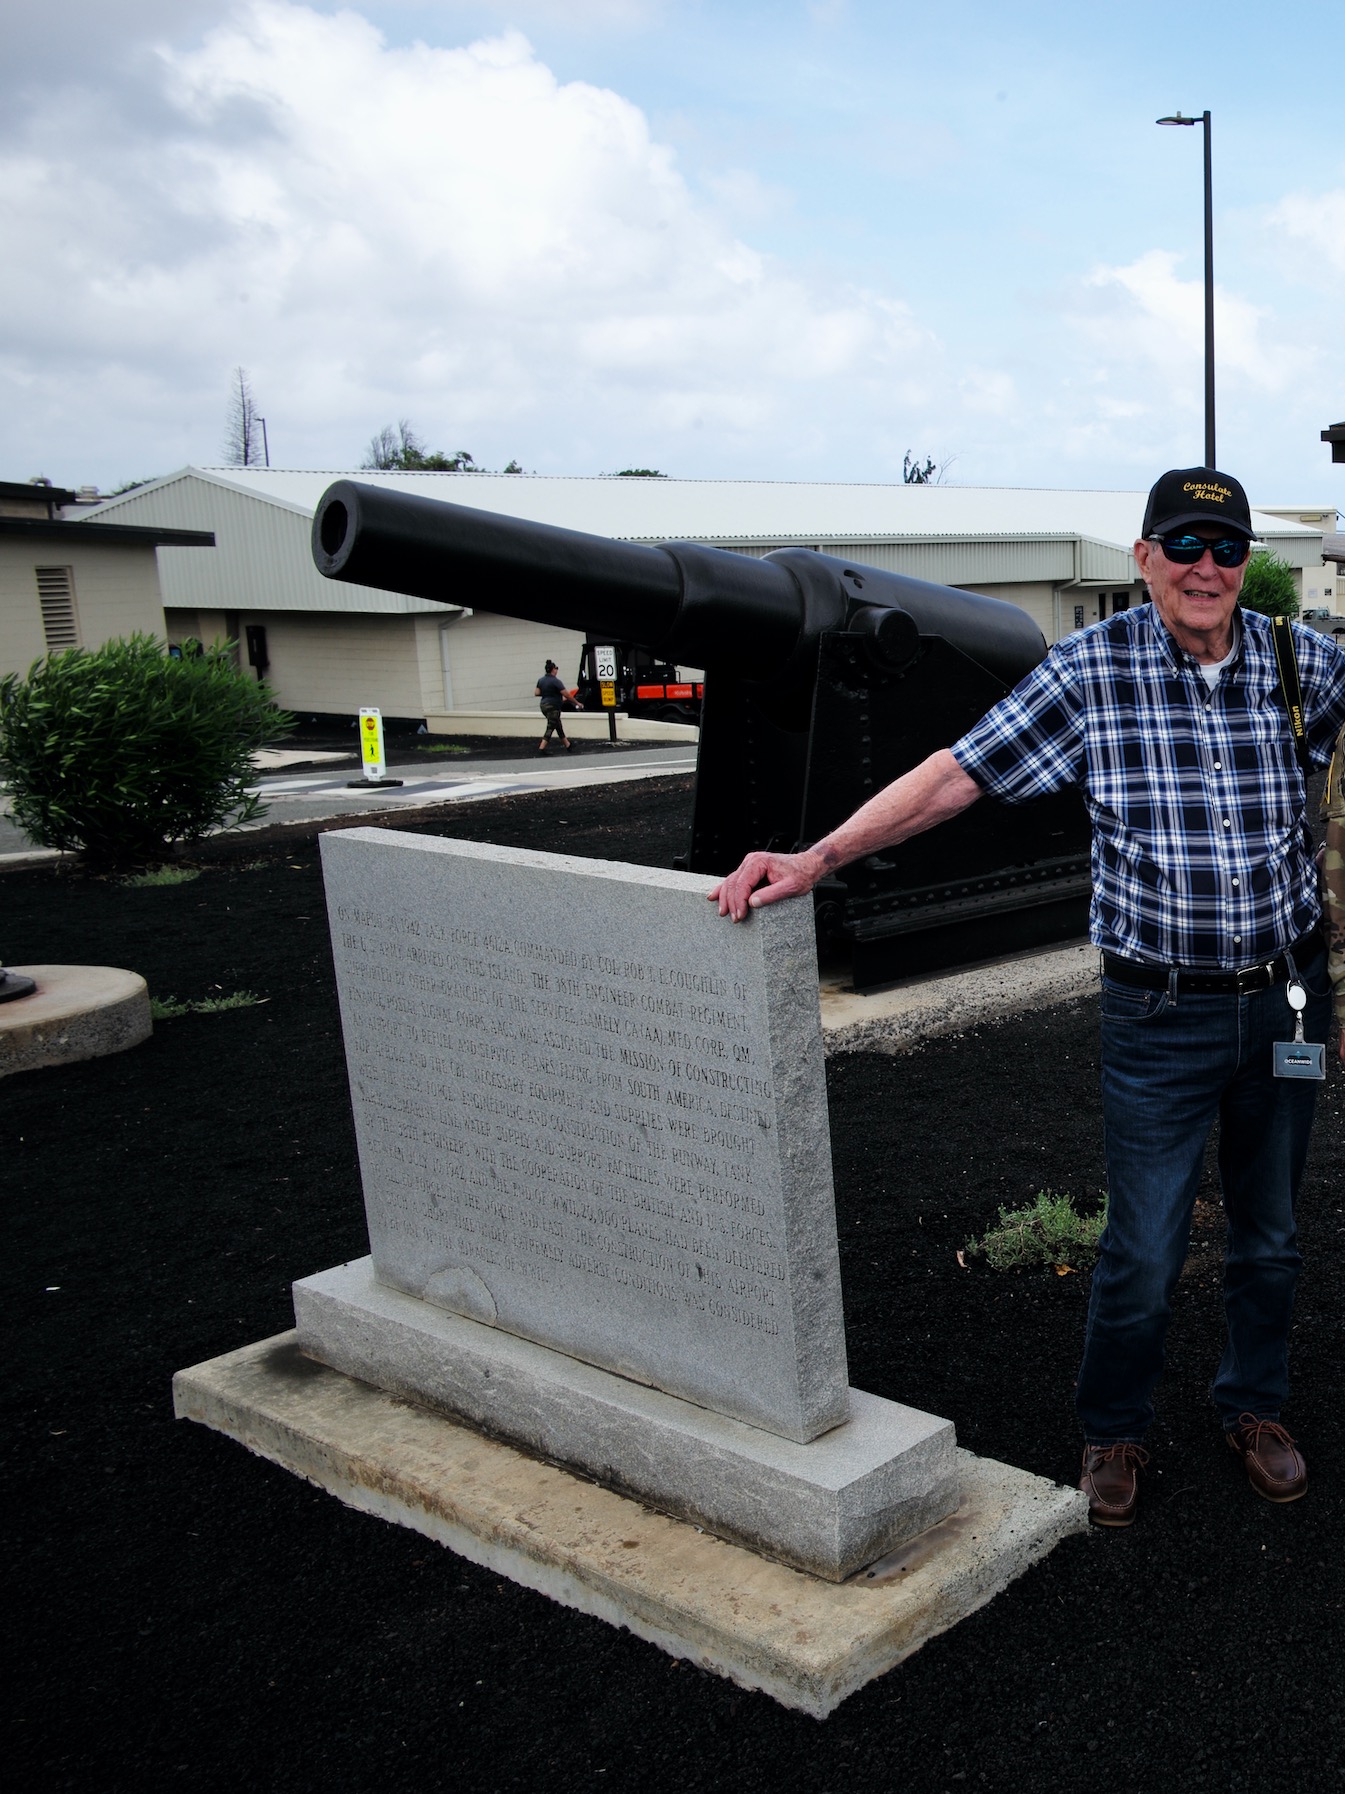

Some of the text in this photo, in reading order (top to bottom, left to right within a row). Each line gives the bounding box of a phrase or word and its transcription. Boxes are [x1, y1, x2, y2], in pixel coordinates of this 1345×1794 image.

[1183, 481, 1232, 498] Consulate
[1192, 489, 1225, 504] Hotel
[598, 665, 613, 676] 20
[1291, 705, 1304, 738] Nikon
[340, 931, 358, 950] THE
[530, 969, 550, 990] THE
[553, 974, 581, 997] 38TH
[583, 980, 636, 1008] ENGINEER
[639, 991, 685, 1019] COMBAT
[579, 951, 595, 971] BY
[732, 980, 748, 1001] OF
[491, 990, 505, 1009] OF
[507, 993, 528, 1015] THE
[517, 1023, 539, 1044] WAS
[540, 1028, 591, 1057] ASSIGNED
[593, 1040, 615, 1062] THE
[618, 1046, 665, 1074] MISSION
[666, 1057, 682, 1078] OF
[683, 1061, 773, 1100] CONSTRUCTING
[595, 1069, 623, 1093] FROM
[626, 1077, 661, 1102] SOUTH
[664, 1086, 718, 1118] AMERICA,
[718, 1099, 772, 1130] DESTINED
[525, 1106, 548, 1128] AND
[549, 1112, 625, 1149] CONSTRUCTION
[626, 1133, 642, 1154] OF
[645, 1138, 667, 1161] THE
[670, 1145, 720, 1178] RUNWAY,
[587, 1095, 611, 1118] AND
[613, 1102, 664, 1132] SUPPLIES
[666, 1115, 698, 1141] WERE
[701, 1124, 757, 1156] BROUGHT
[498, 1150, 519, 1172] THE
[590, 1178, 605, 1198] OF
[607, 1182, 629, 1205] THE
[632, 1190, 675, 1219] BRITISH
[678, 1203, 704, 1228] AND
[556, 1141, 603, 1171] SUPPORT
[663, 1171, 694, 1197] WERE
[697, 1181, 766, 1218] PERFORMED
[676, 1258, 691, 1279] OF
[726, 1274, 776, 1307] AIRPORT
[723, 1245, 786, 1282] DELIVERED
